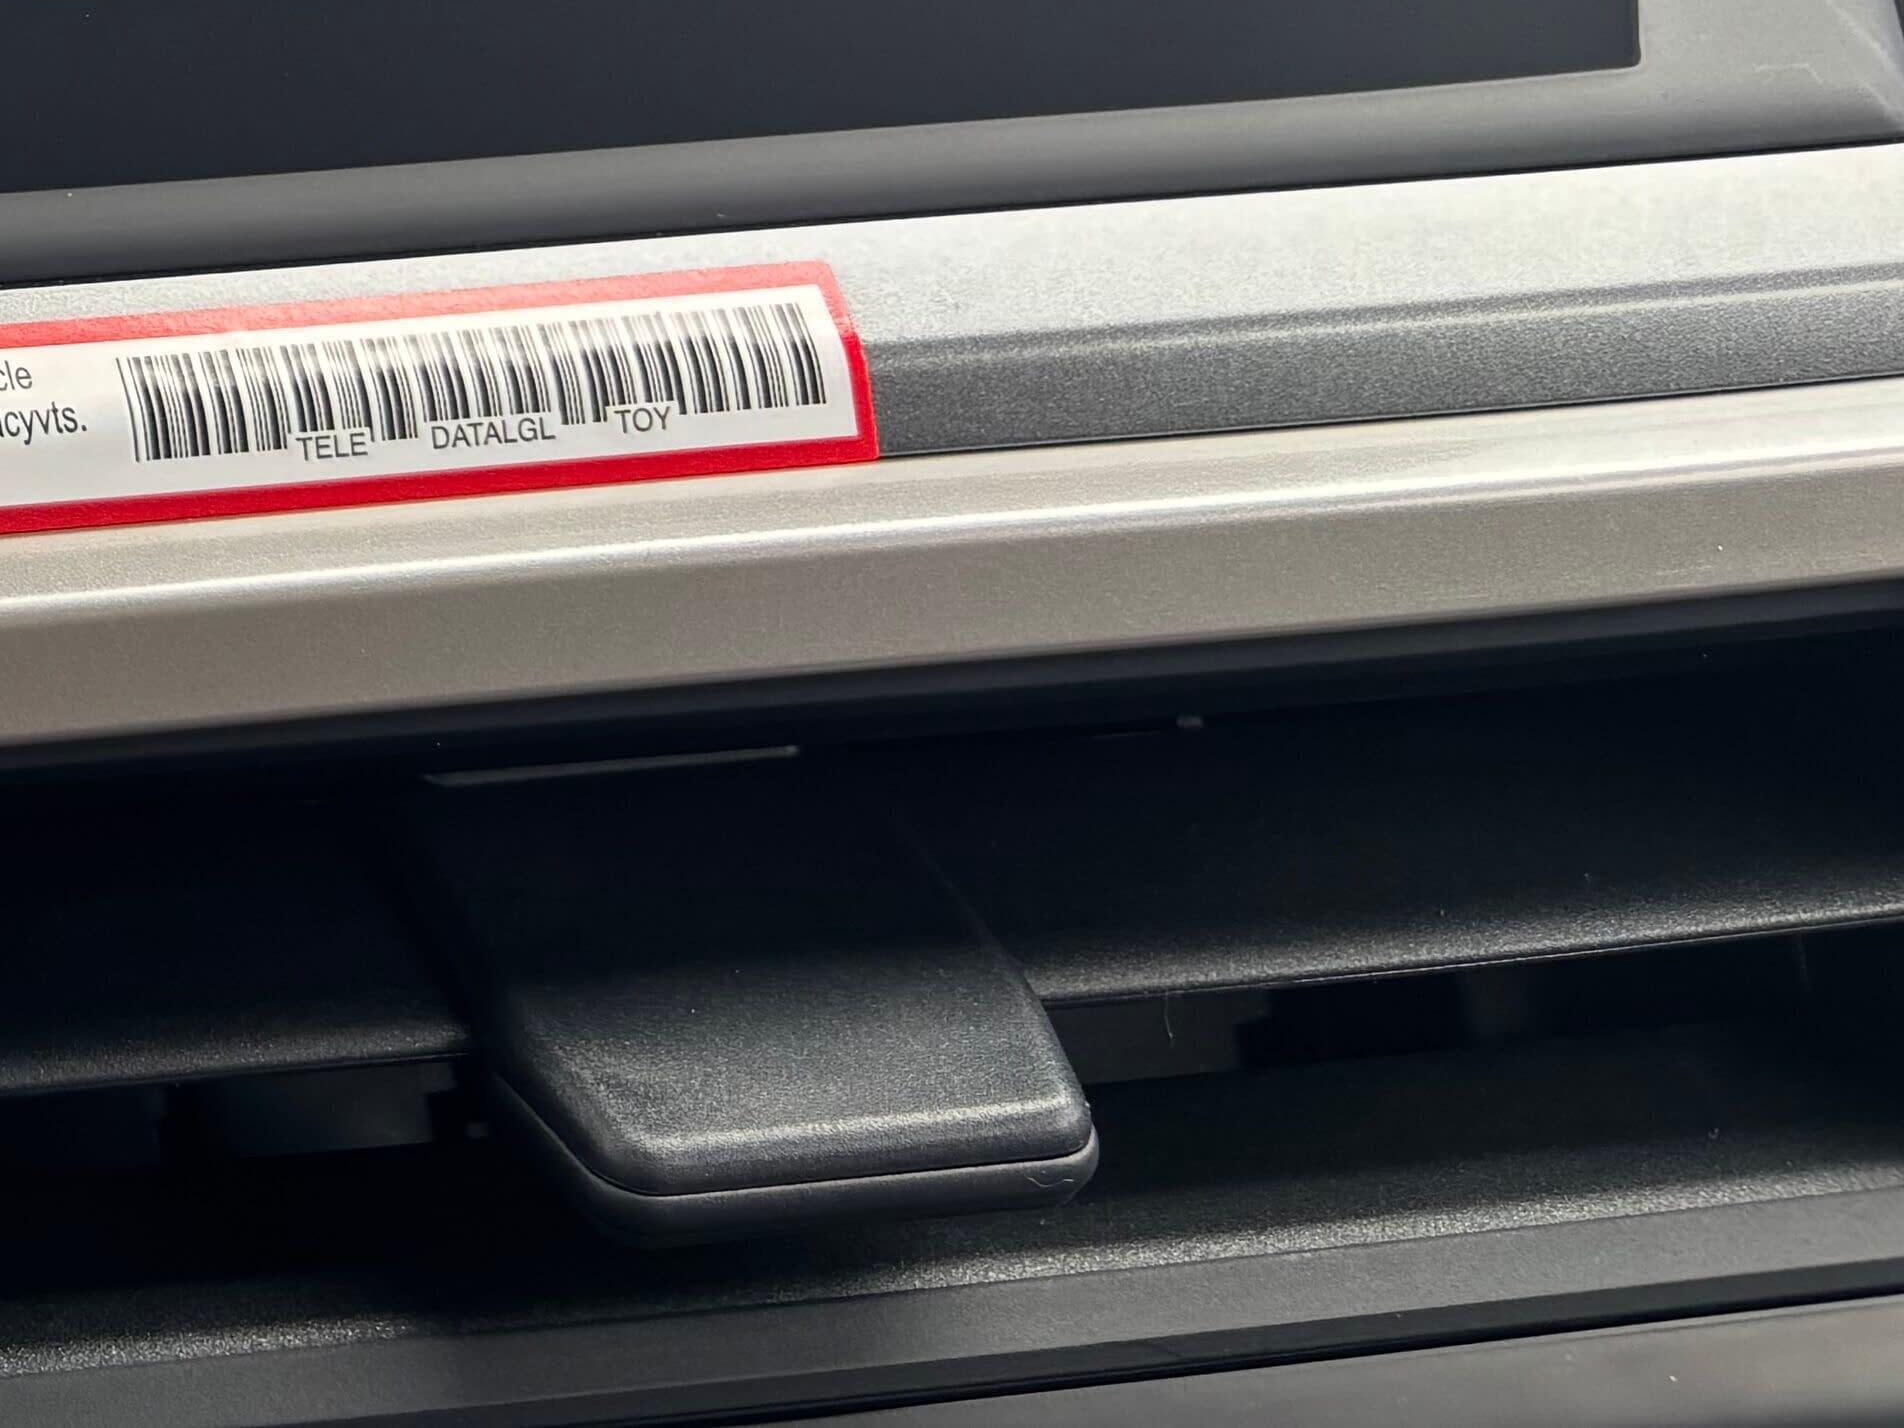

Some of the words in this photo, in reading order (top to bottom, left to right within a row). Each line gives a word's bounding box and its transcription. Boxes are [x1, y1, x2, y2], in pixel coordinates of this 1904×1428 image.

[296, 433, 368, 462] TELE
[430, 416, 556, 451] DATALGL
[613, 406, 671, 435] TOY
